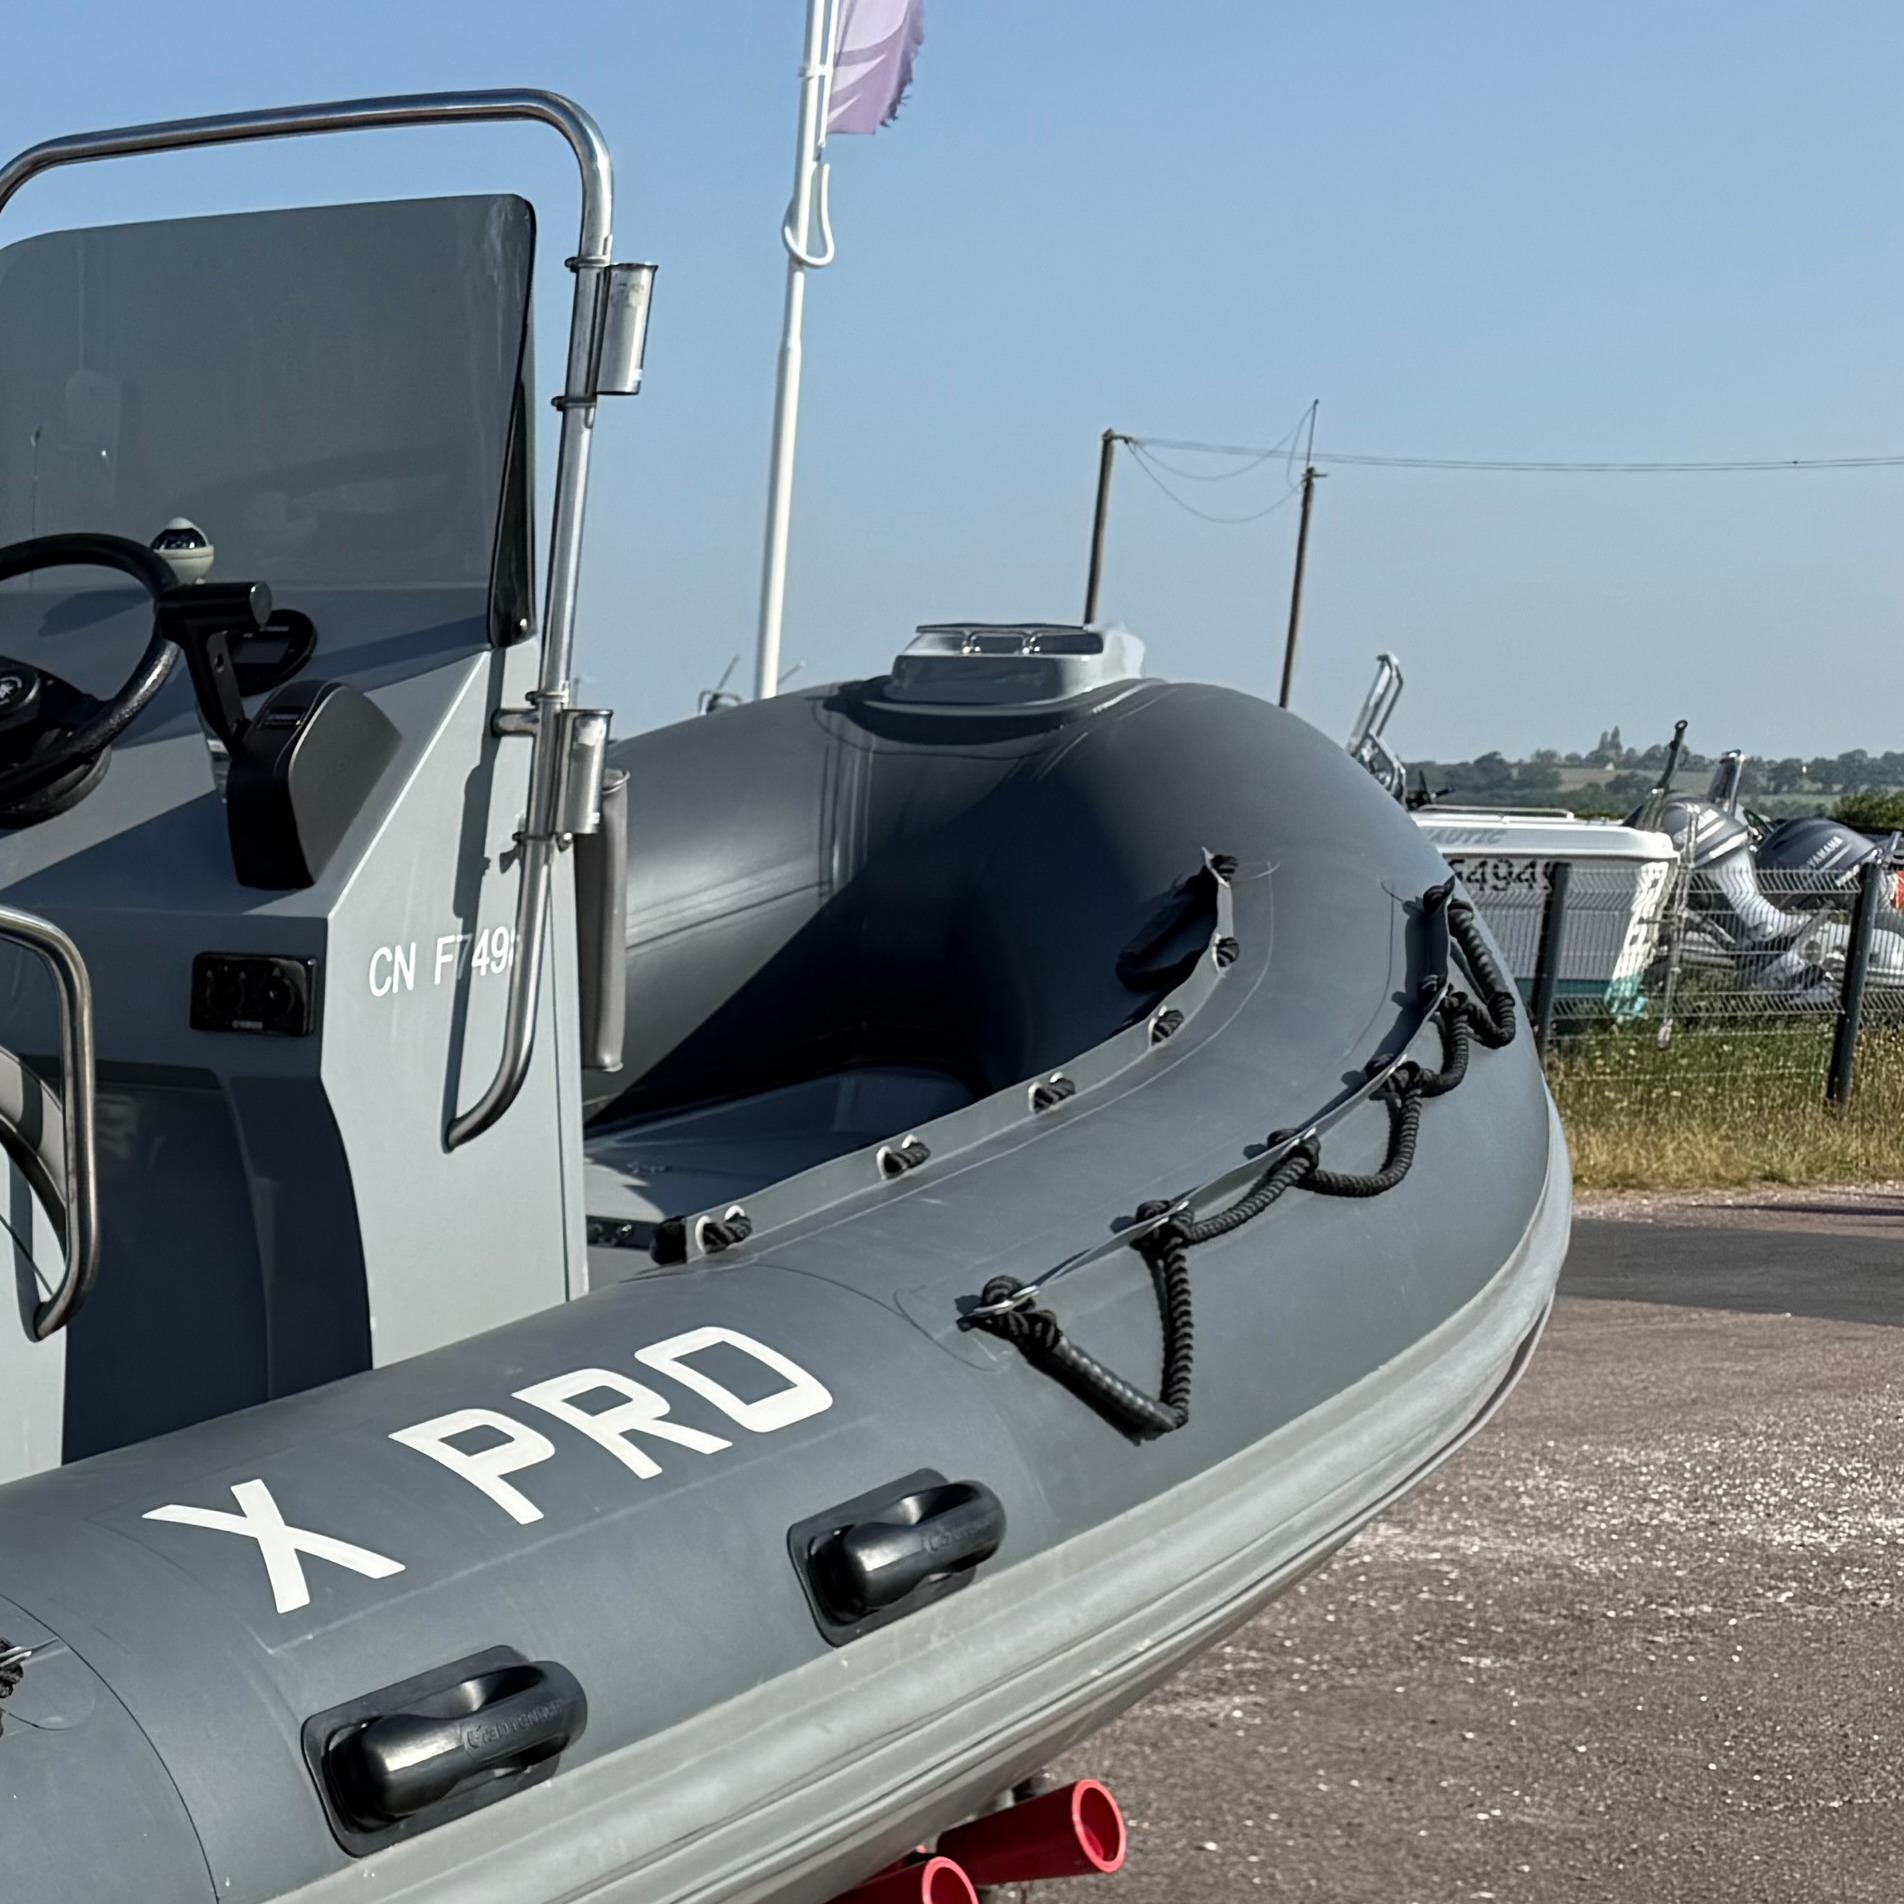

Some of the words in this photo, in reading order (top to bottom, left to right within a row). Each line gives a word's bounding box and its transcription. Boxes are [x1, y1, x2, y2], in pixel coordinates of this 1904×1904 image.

[368, 941, 417, 998] CN
[141, 1477, 406, 1614] X
[387, 1326, 834, 1526] PRO
